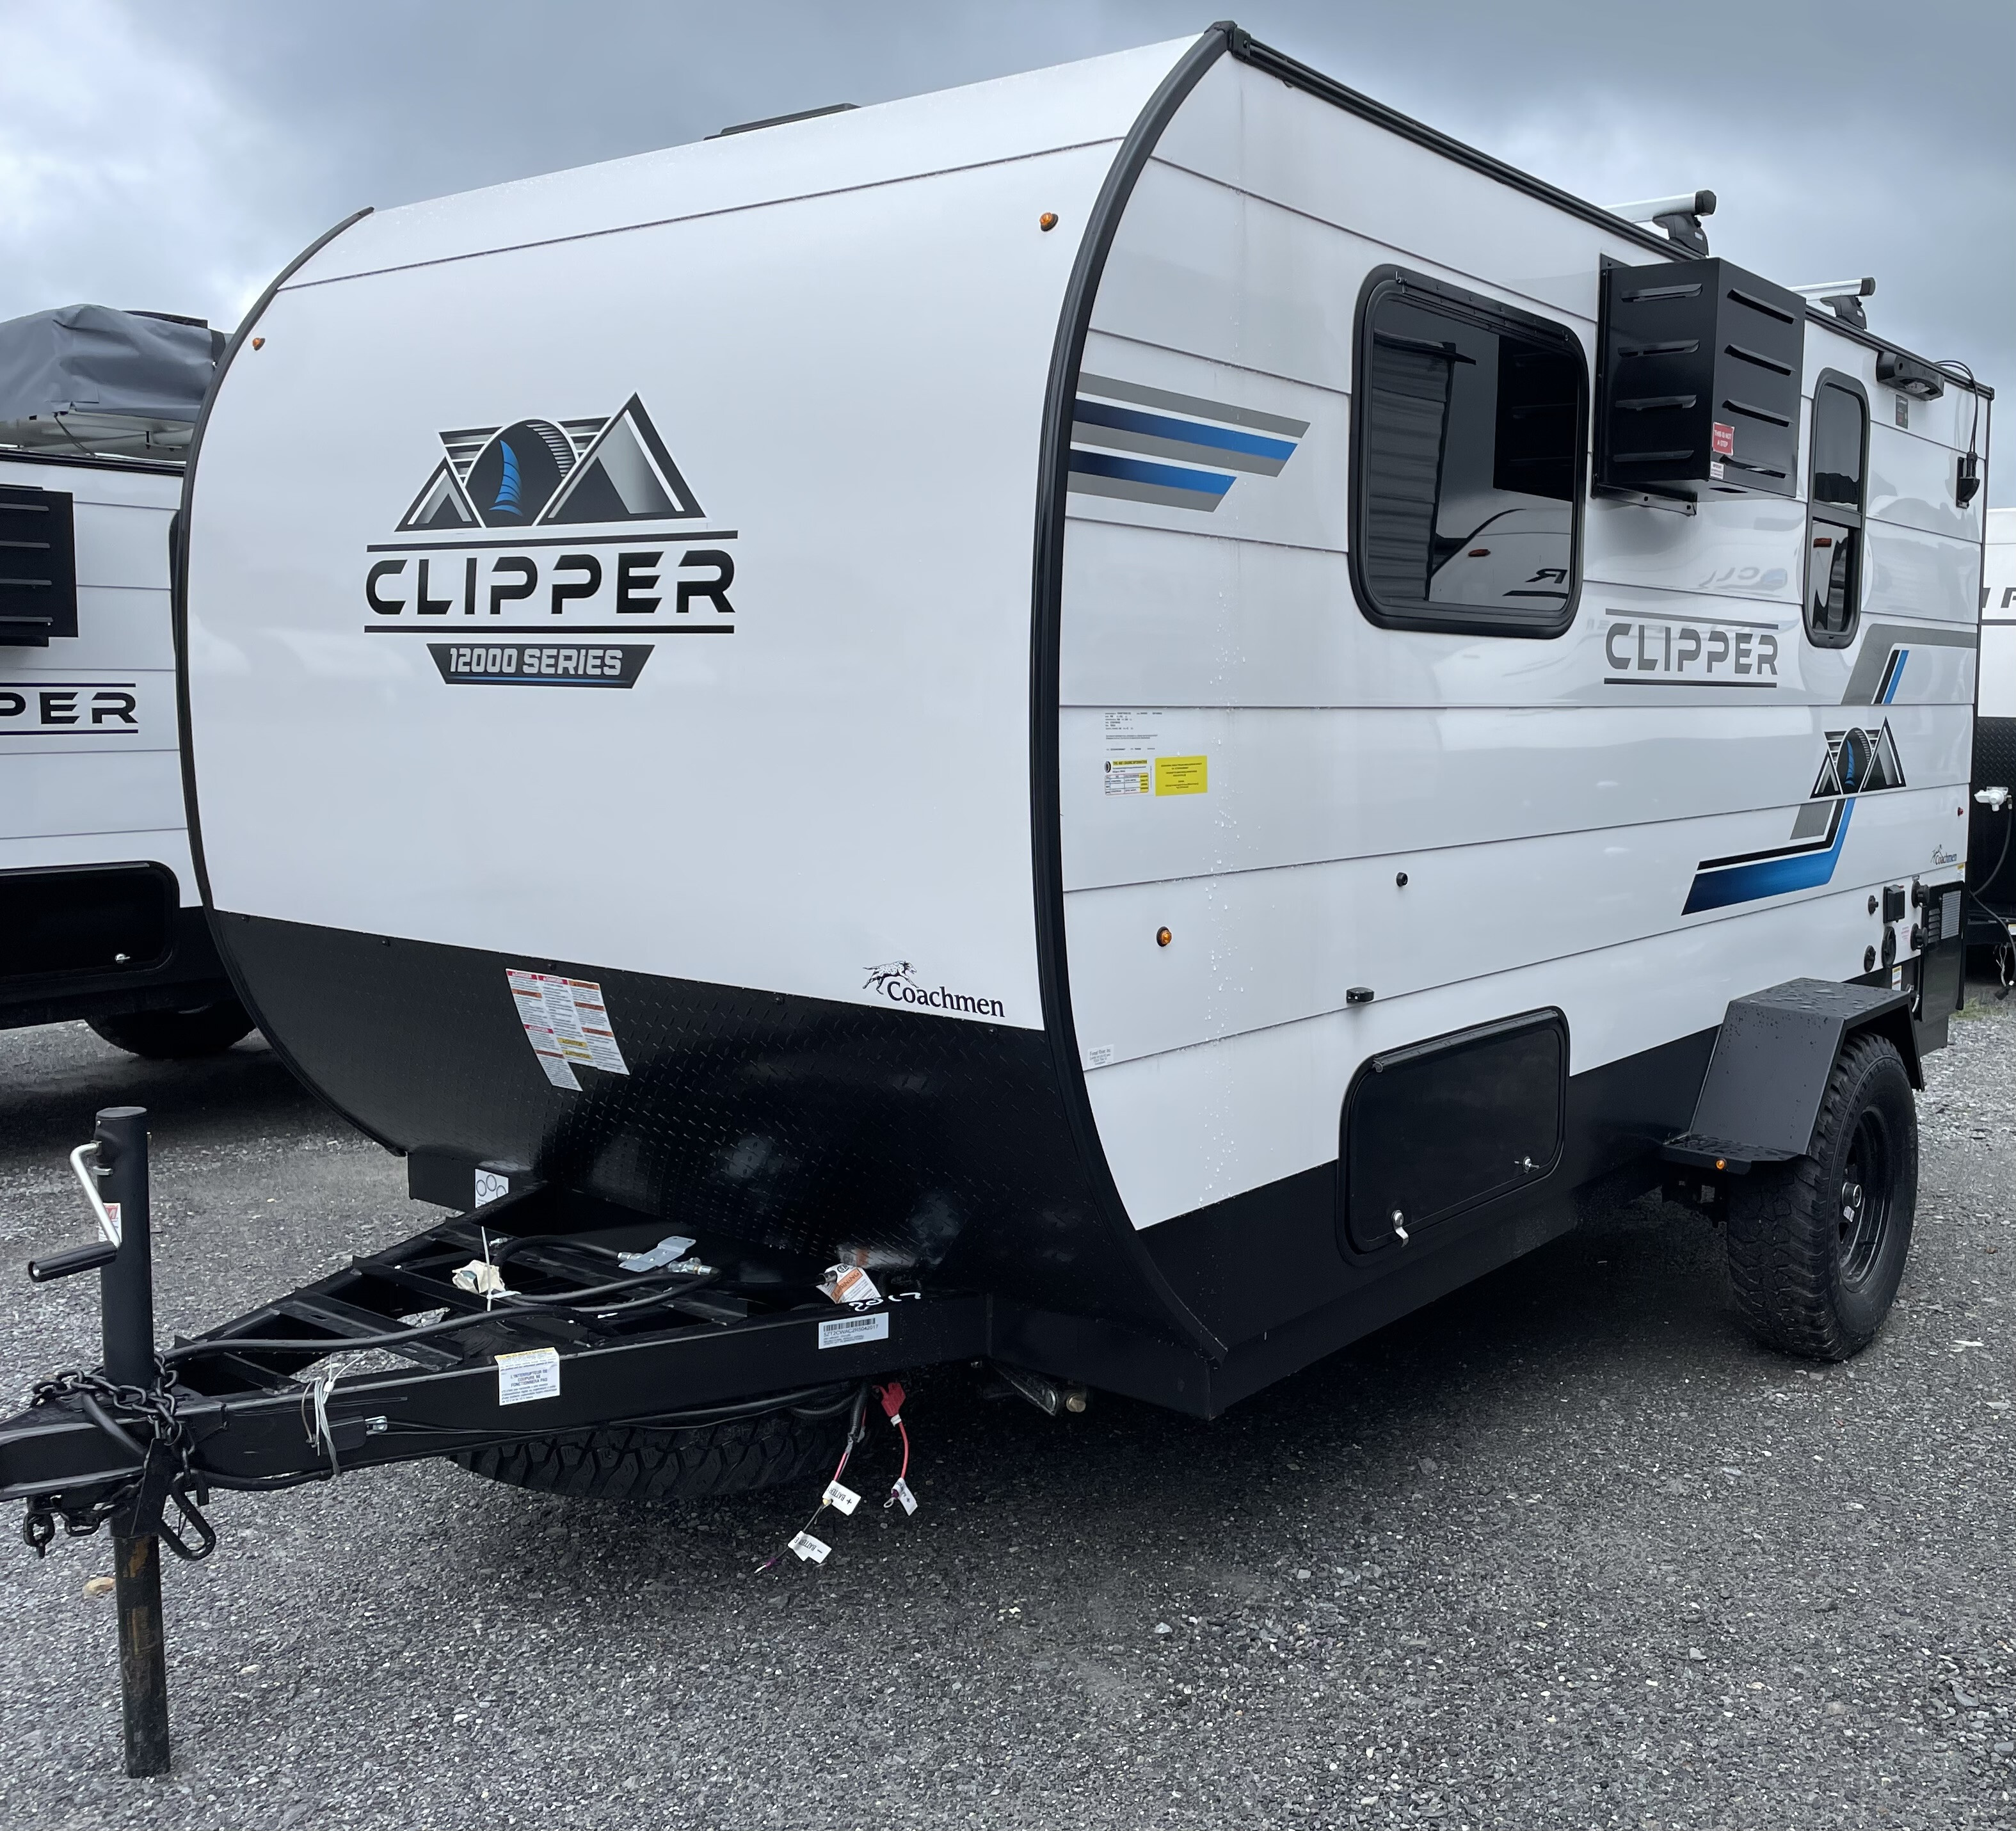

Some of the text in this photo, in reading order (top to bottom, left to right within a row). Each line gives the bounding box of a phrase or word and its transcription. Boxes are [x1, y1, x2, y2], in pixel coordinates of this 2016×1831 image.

[365, 549, 735, 615] CLIPPER
[449, 648, 623, 676] 12000 SERIES
[1605, 623, 1779, 675] CLIPPER
[886, 980, 1005, 1018] Coachmen
